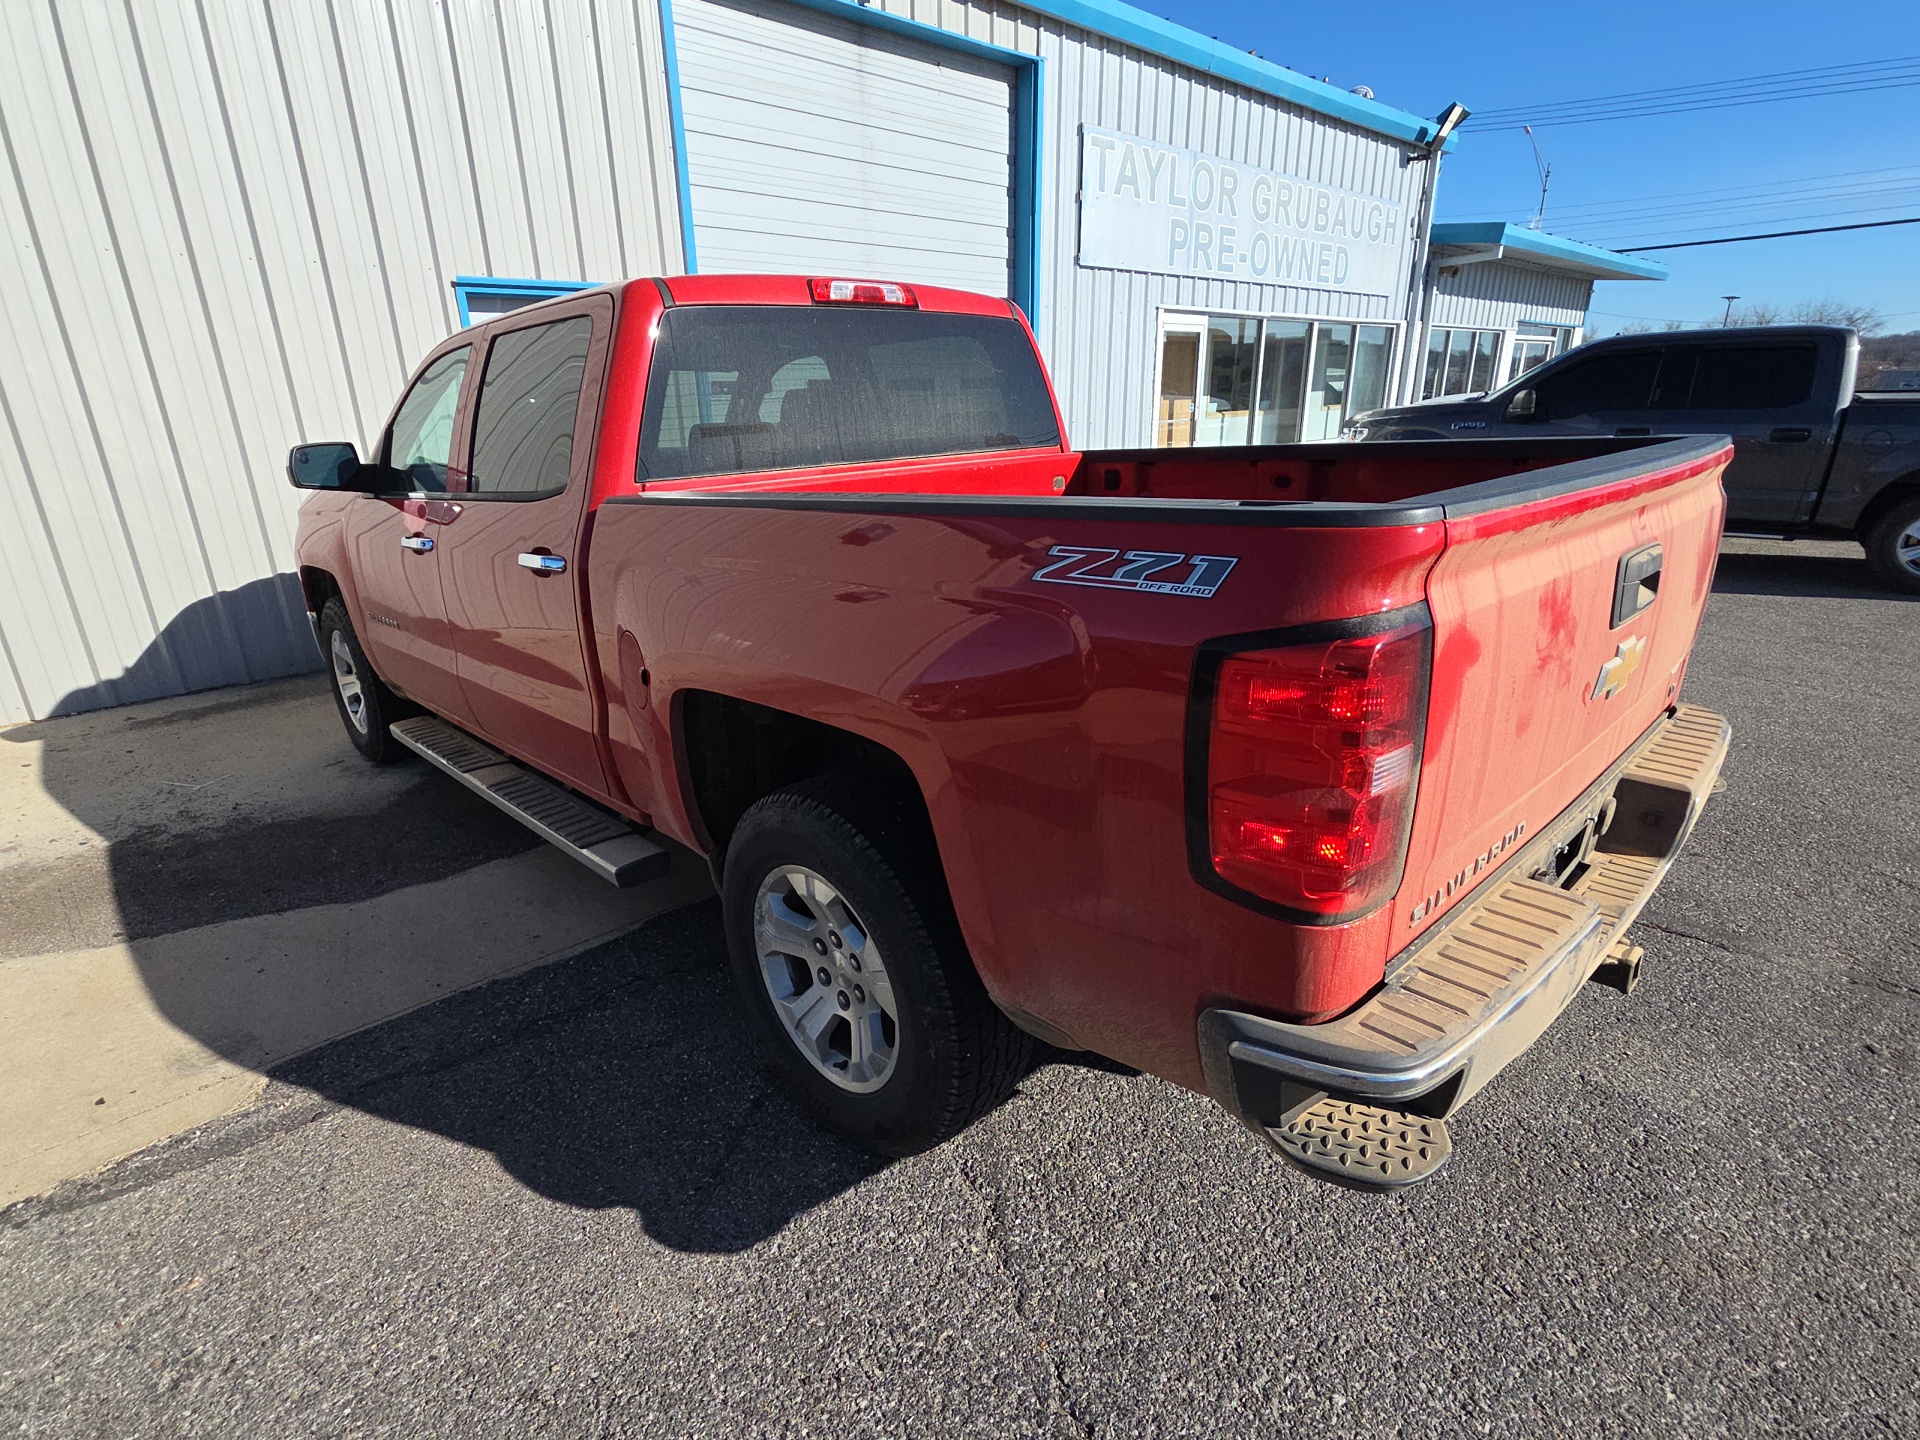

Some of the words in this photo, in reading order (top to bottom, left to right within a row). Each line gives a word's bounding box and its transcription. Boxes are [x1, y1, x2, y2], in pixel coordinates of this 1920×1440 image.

[1089, 133, 1239, 218] TAYLOR
[1250, 173, 1400, 247] GRUBAUGH
[1167, 216, 1350, 286] PRE-OWNED
[1032, 545, 1239, 590] Z71
[1138, 581, 1168, 592] OFF
[1169, 584, 1213, 597] ROAD
[1408, 820, 1527, 930] SILVERADO
